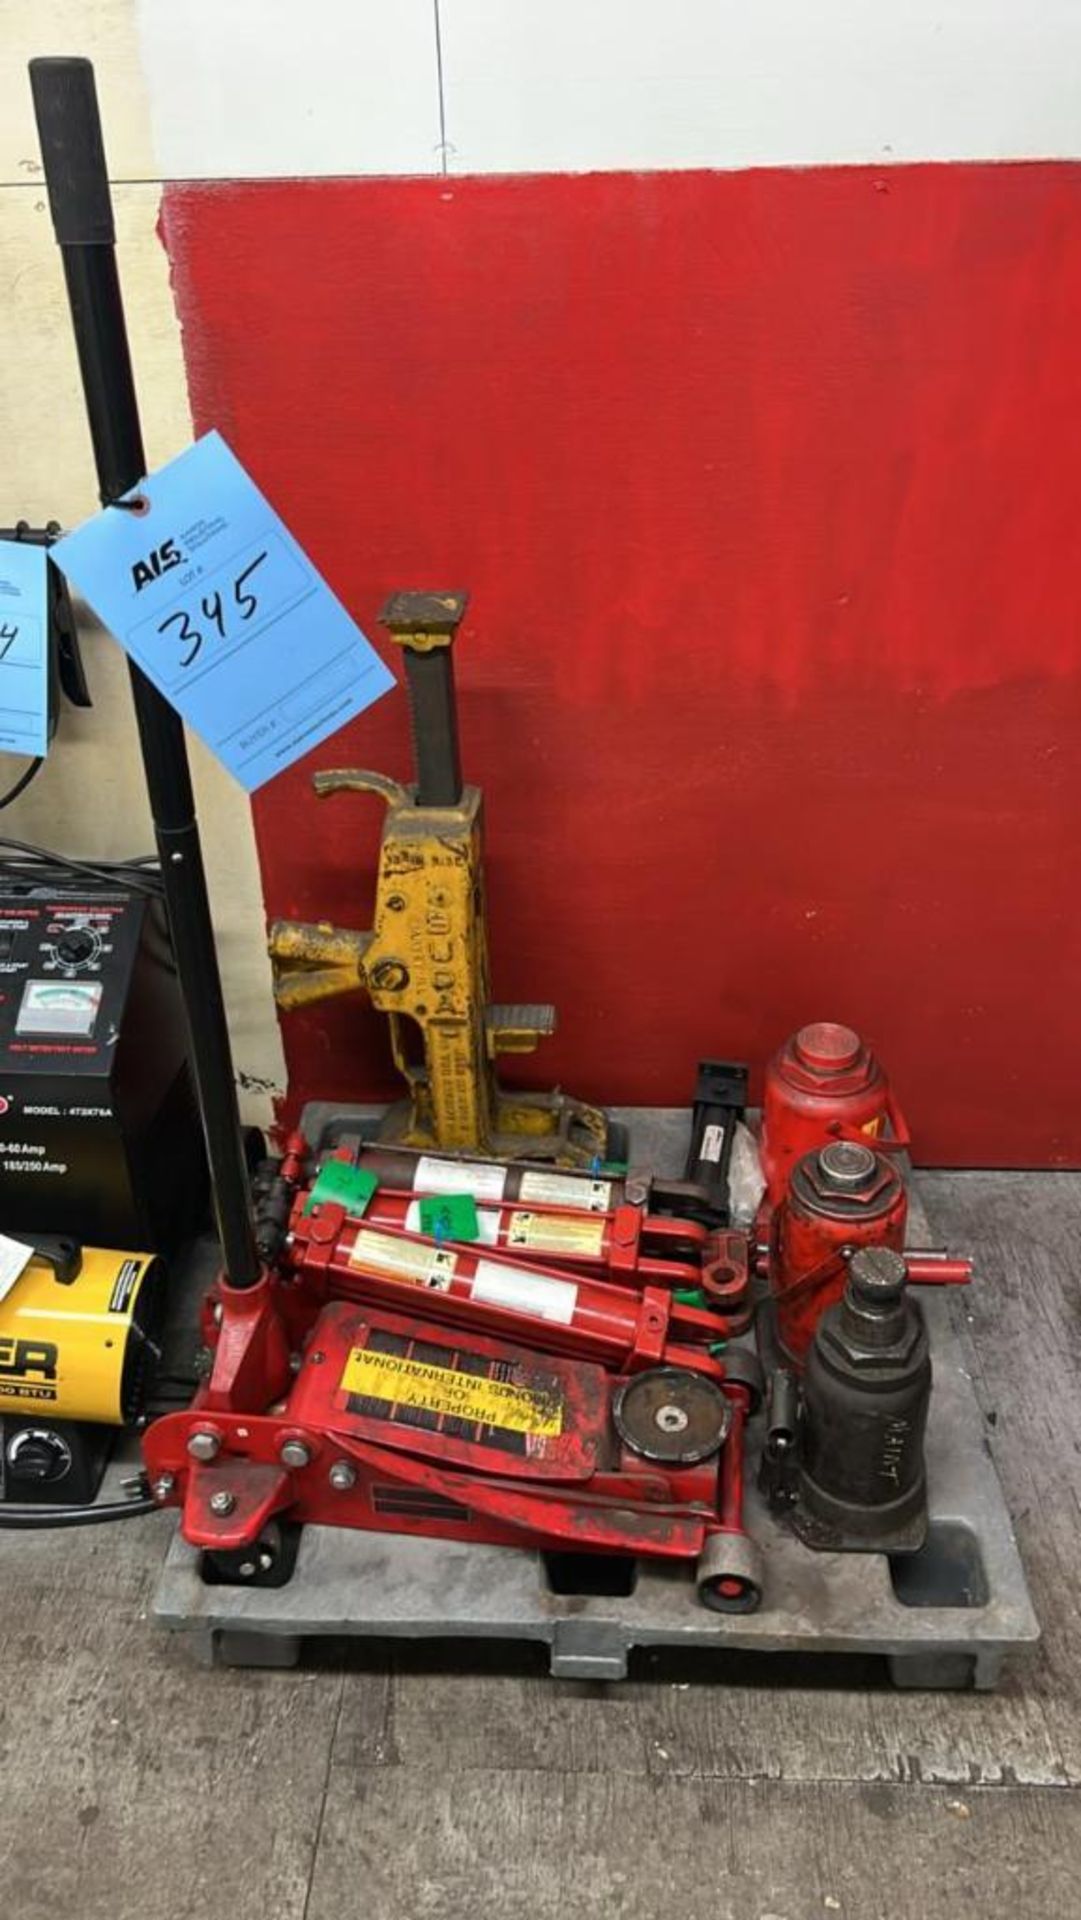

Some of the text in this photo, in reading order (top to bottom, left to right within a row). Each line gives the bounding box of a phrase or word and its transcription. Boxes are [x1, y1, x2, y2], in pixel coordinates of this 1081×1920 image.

[131, 539, 182, 592] AIS
[157, 551, 269, 667] 345
[24, 1106, 60, 1117] MODEL
[22, 1144, 46, 1156] Amp
[43, 1161, 67, 1175] Amp
[355, 1351, 481, 1390] INTERNATIONAL
[19, 1388, 52, 1399] BTU
[446, 1389, 466, 1400] OF
[407, 1393, 498, 1423] PROPERTY
